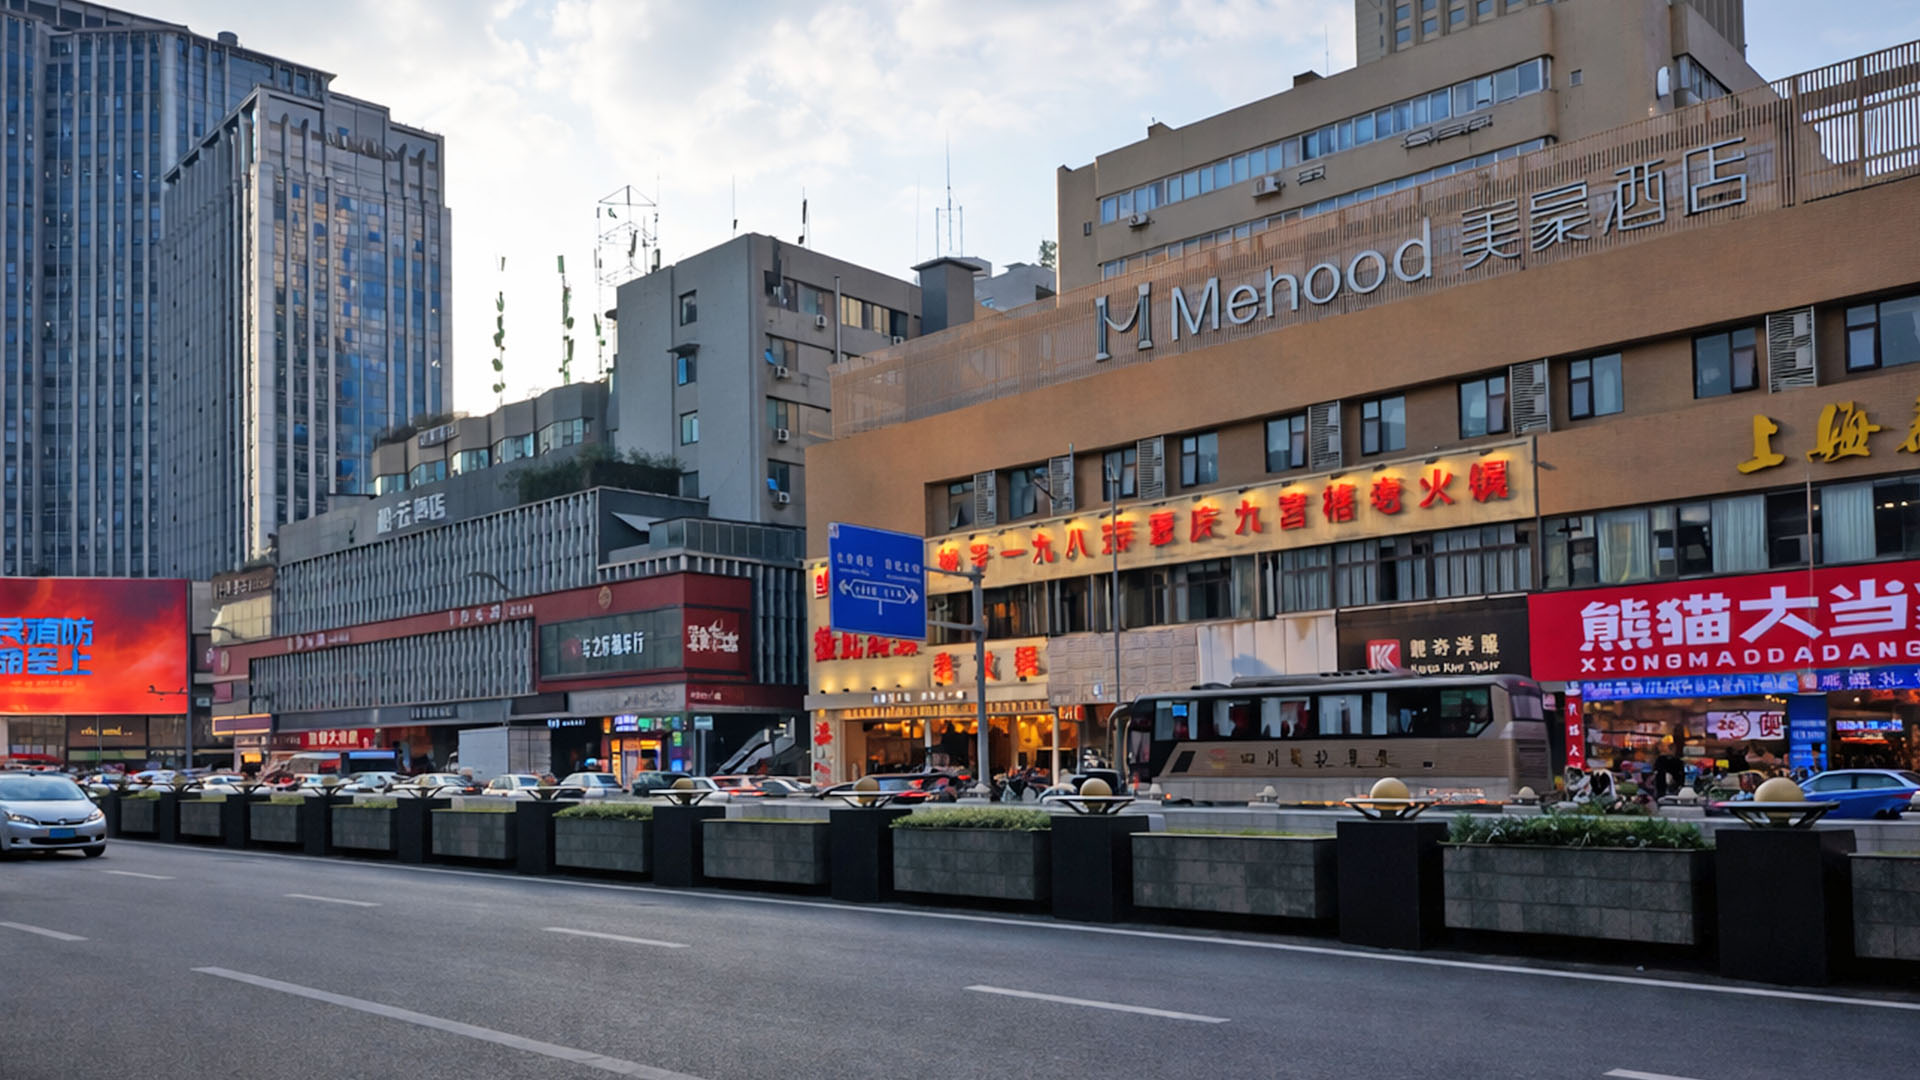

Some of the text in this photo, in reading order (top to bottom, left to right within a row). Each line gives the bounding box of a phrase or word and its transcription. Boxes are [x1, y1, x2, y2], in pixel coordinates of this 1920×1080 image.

[1171, 216, 1432, 342] Mehood
[1579, 578, 1920, 652] 熊猫大当
